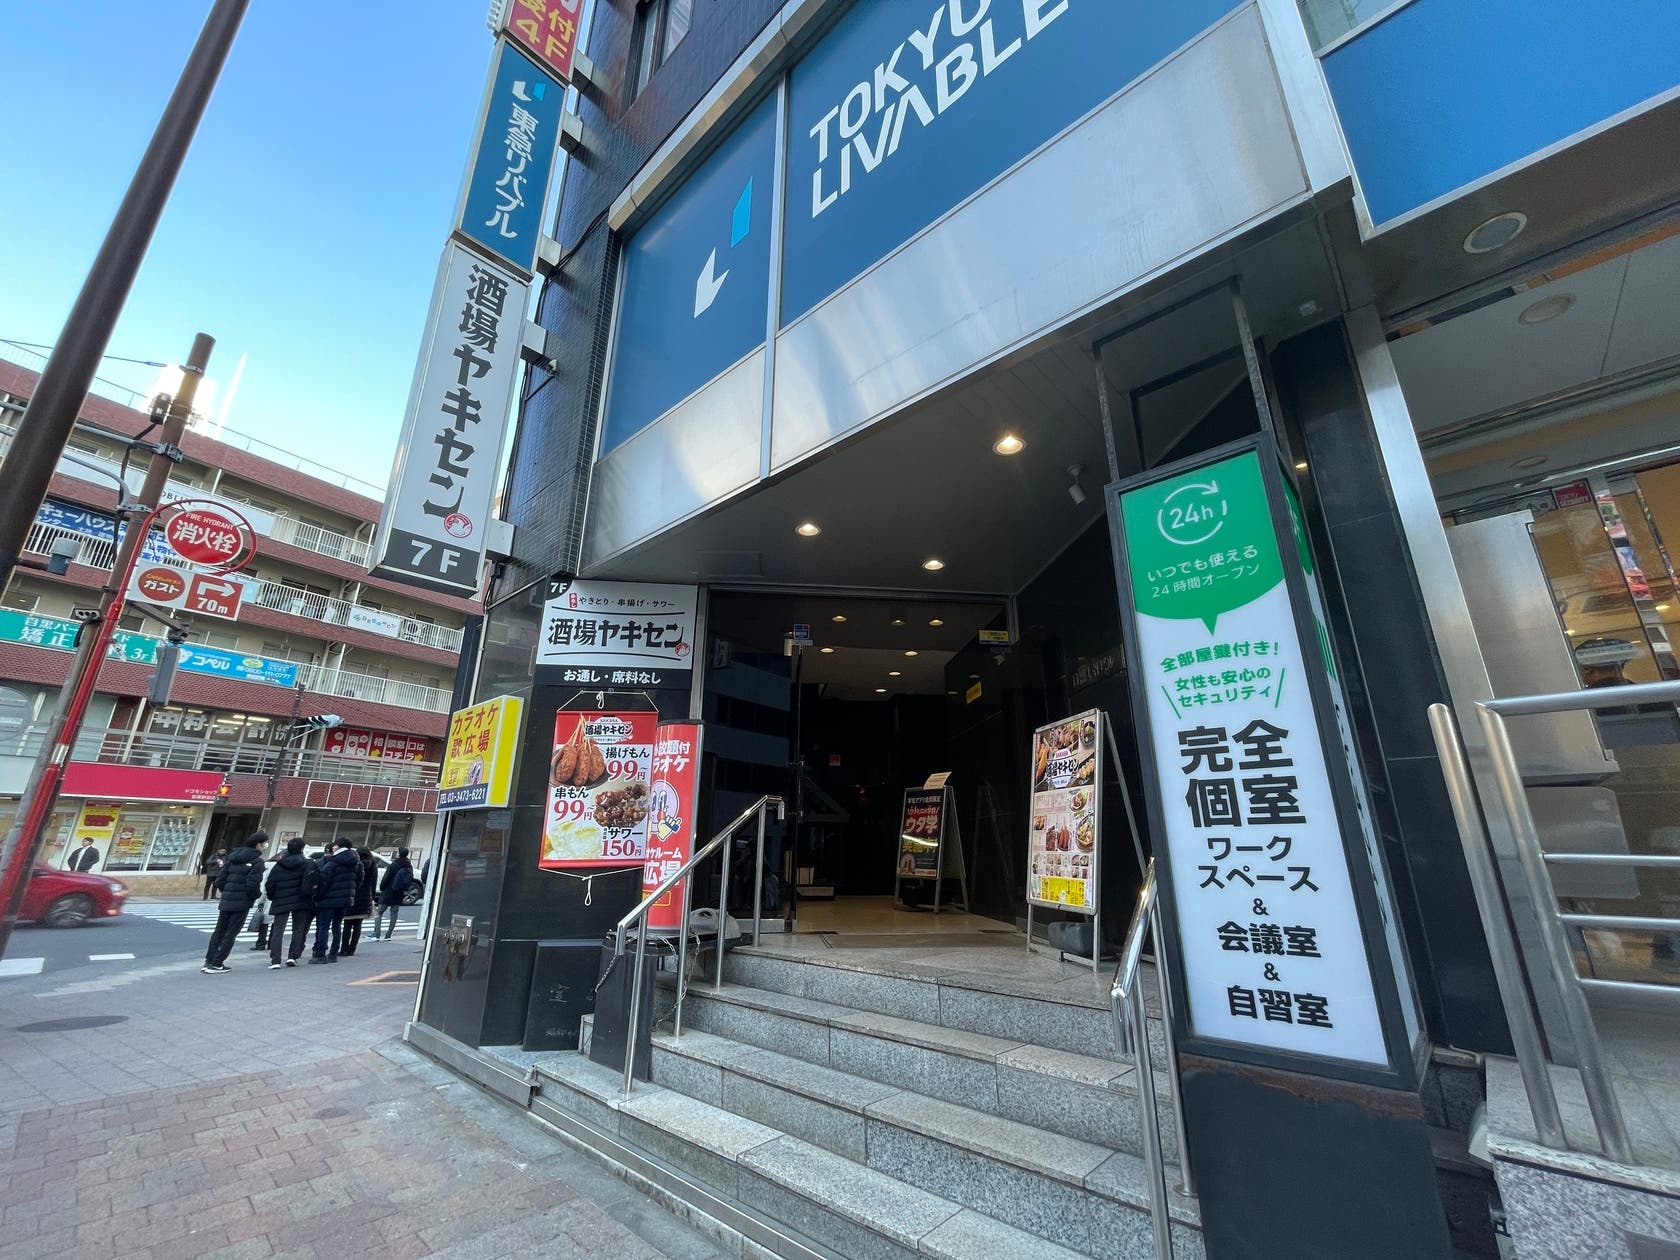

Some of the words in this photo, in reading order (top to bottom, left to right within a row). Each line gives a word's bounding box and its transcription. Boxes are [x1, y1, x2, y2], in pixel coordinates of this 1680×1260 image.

[516, 19, 567, 58] 4F
[486, 103, 539, 238] 東急リバブル
[422, 264, 509, 518] 酒場ヤキセン
[185, 512, 202, 523] FIRE
[202, 516, 234, 531] HYDRANT
[1169, 503, 1214, 530] 24h
[172, 519, 237, 554] 消火栓
[410, 539, 461, 574] 7F
[1147, 544, 1258, 583] いつでも使える
[143, 579, 180, 594] ガスト
[550, 582, 568, 593] 7F
[197, 596, 229, 615] 70m
[549, 617, 685, 649] 酒場ヤキセン
[192, 656, 231, 670] コペル
[1160, 641, 1279, 673] 全部屋鍵付き!
[564, 670, 661, 684] お通し・席料なし
[1175, 666, 1271, 691] 女性も安心の
[1178, 685, 1271, 708] セキュリティ
[452, 704, 499, 736] カラオケ
[585, 724, 632, 735] 酒場ヤキセン
[451, 729, 490, 759] 歌広場
[605, 747, 650, 759] 揚げもん
[1178, 719, 1293, 775] 完全
[555, 787, 589, 799] 串もん
[1185, 774, 1307, 828] 個室
[607, 828, 643, 840] サワー
[1207, 836, 1292, 861] ワーク
[1198, 865, 1320, 892] スペース
[1252, 898, 1270, 916] &
[1216, 921, 1322, 958] 会議室
[1264, 962, 1281, 981] &
[1226, 984, 1334, 1029] 自習室
